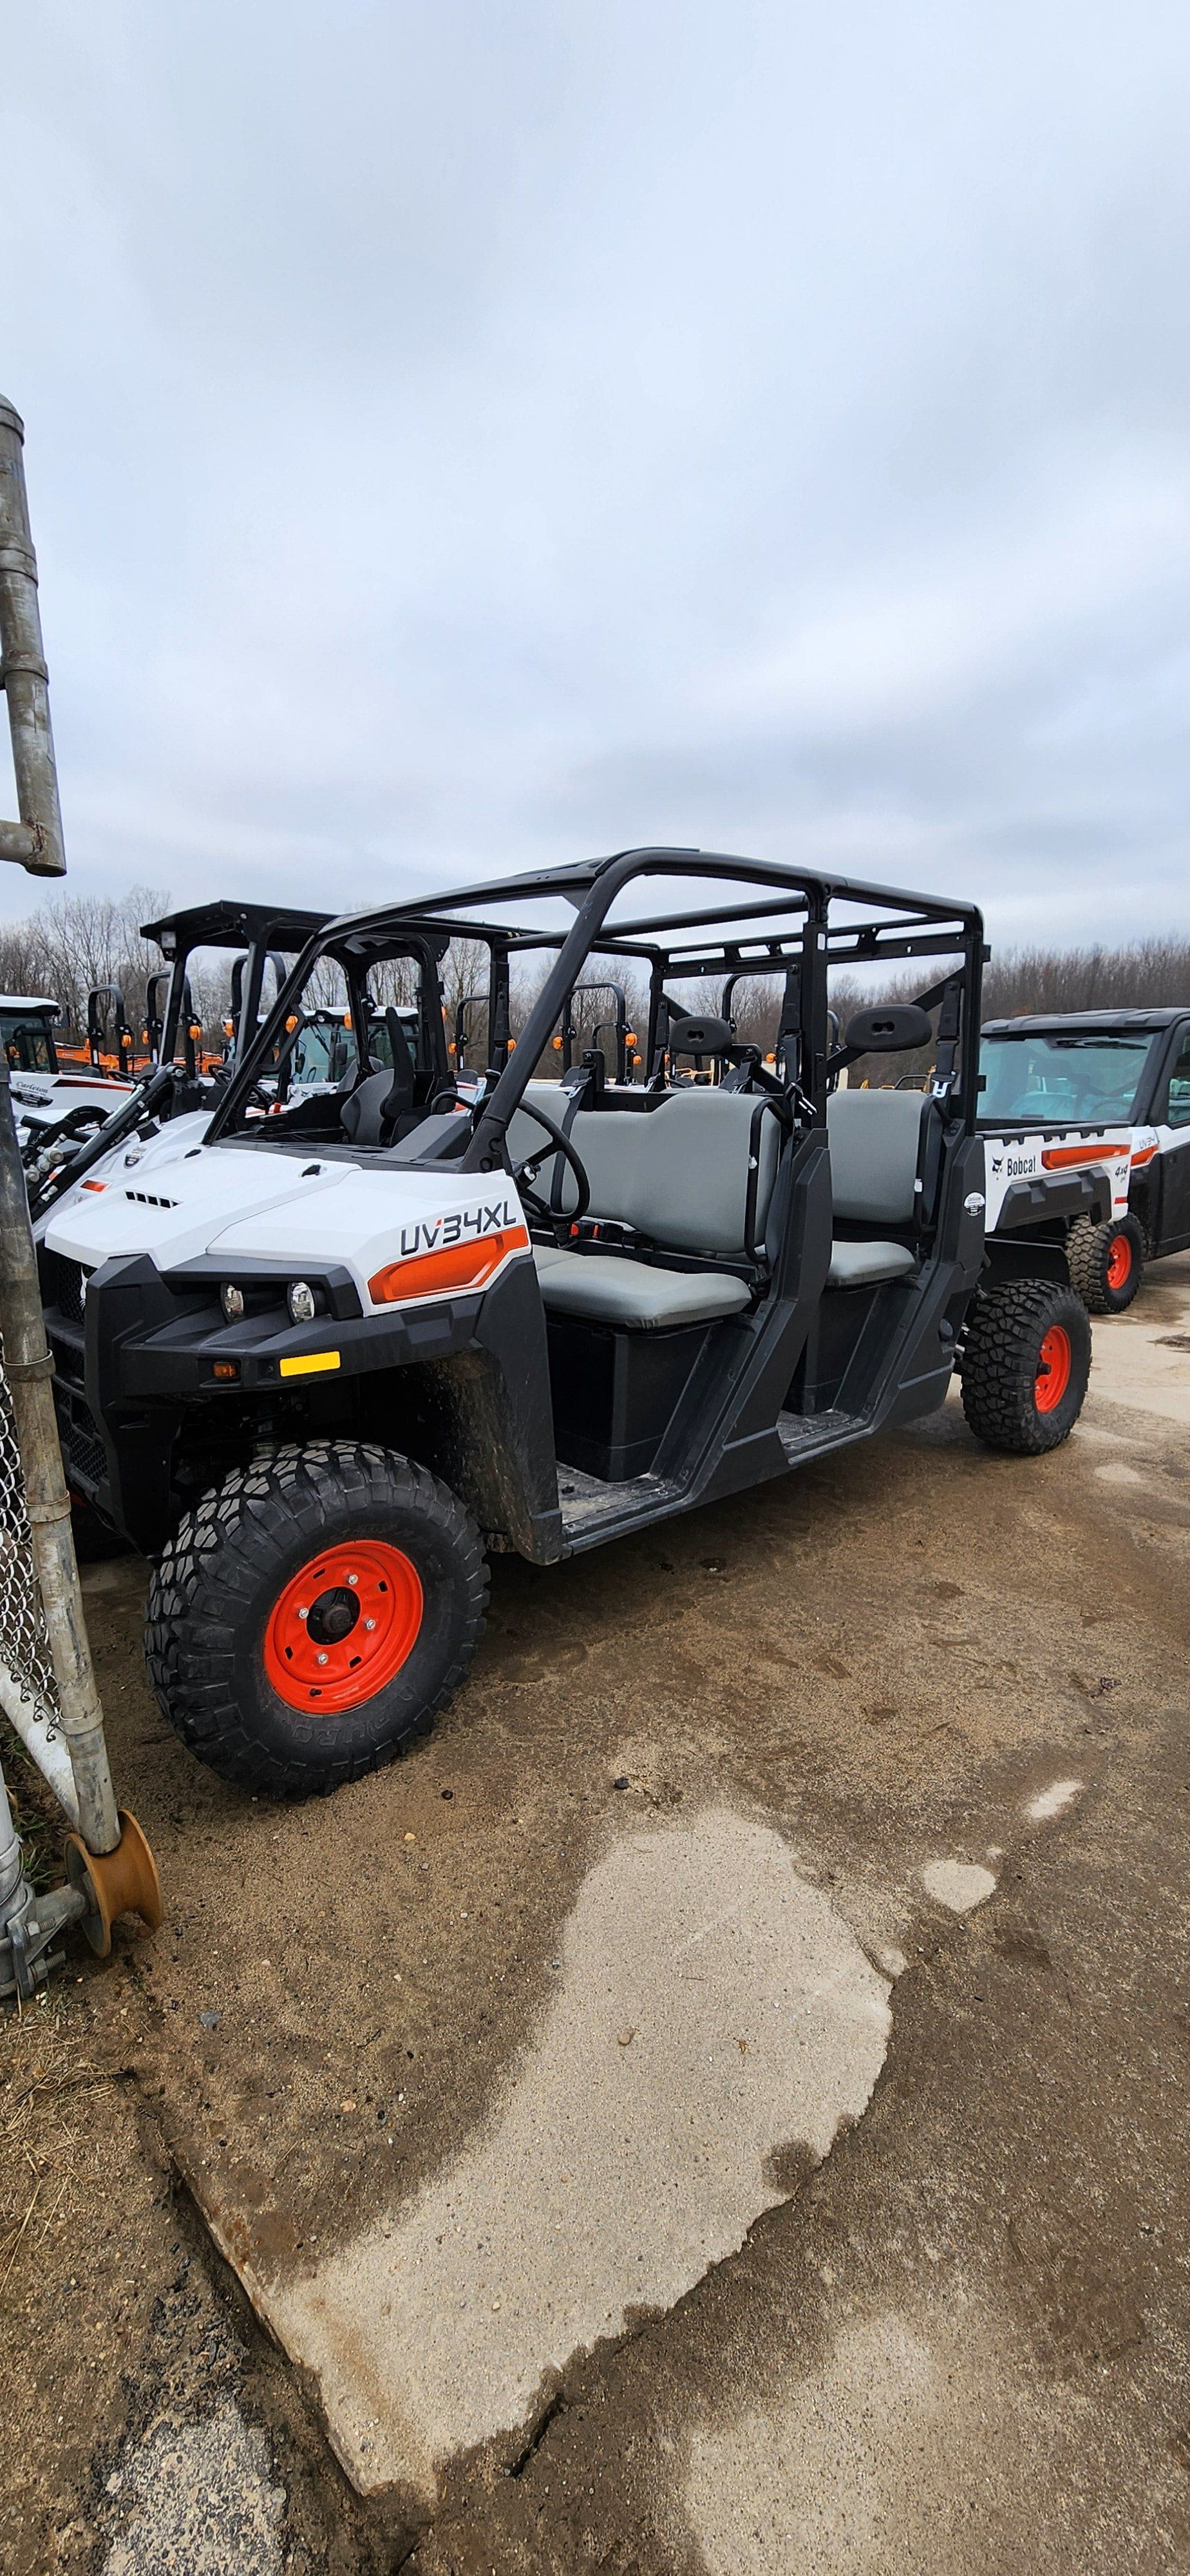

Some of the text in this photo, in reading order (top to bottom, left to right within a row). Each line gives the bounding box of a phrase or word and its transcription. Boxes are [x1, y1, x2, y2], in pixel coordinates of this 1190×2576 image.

[16, 1081, 48, 1094] Carleton
[1007, 1155, 1036, 1177] Bobcat
[401, 1200, 516, 1255] UV34XL
